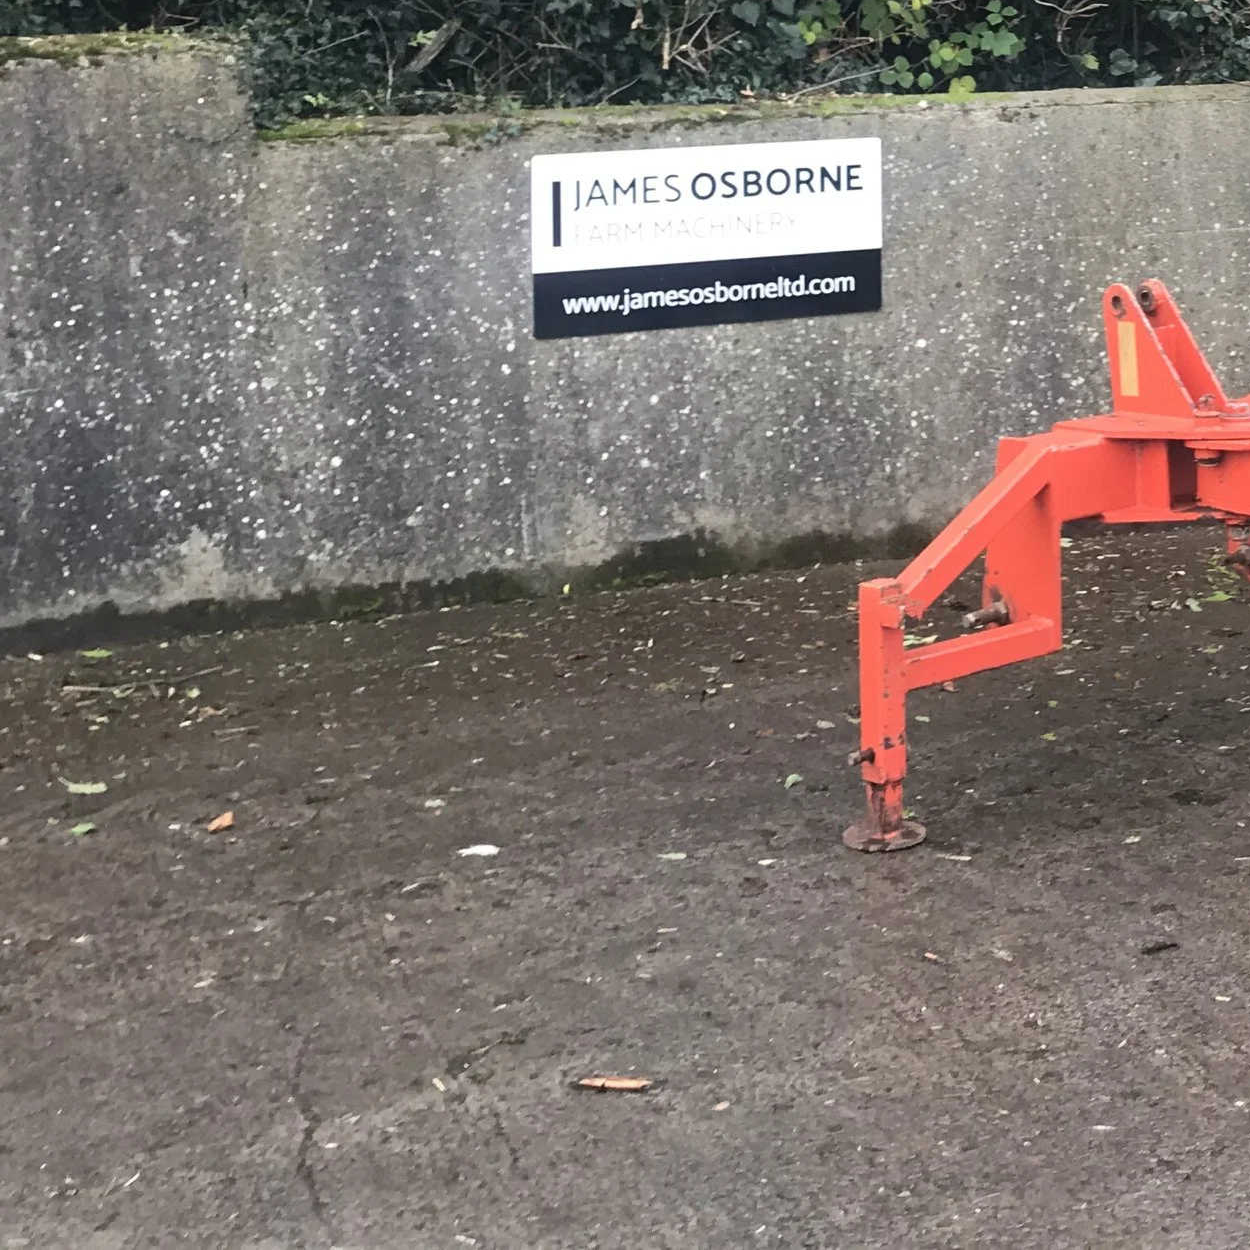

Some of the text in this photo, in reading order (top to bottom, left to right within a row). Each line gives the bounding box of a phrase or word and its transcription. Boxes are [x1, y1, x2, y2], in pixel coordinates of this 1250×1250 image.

[574, 164, 863, 211] JAMES OSBORNE
[574, 213, 798, 245] FARM MACHINERY
[563, 275, 855, 315] www.jamesosborneltd.com
